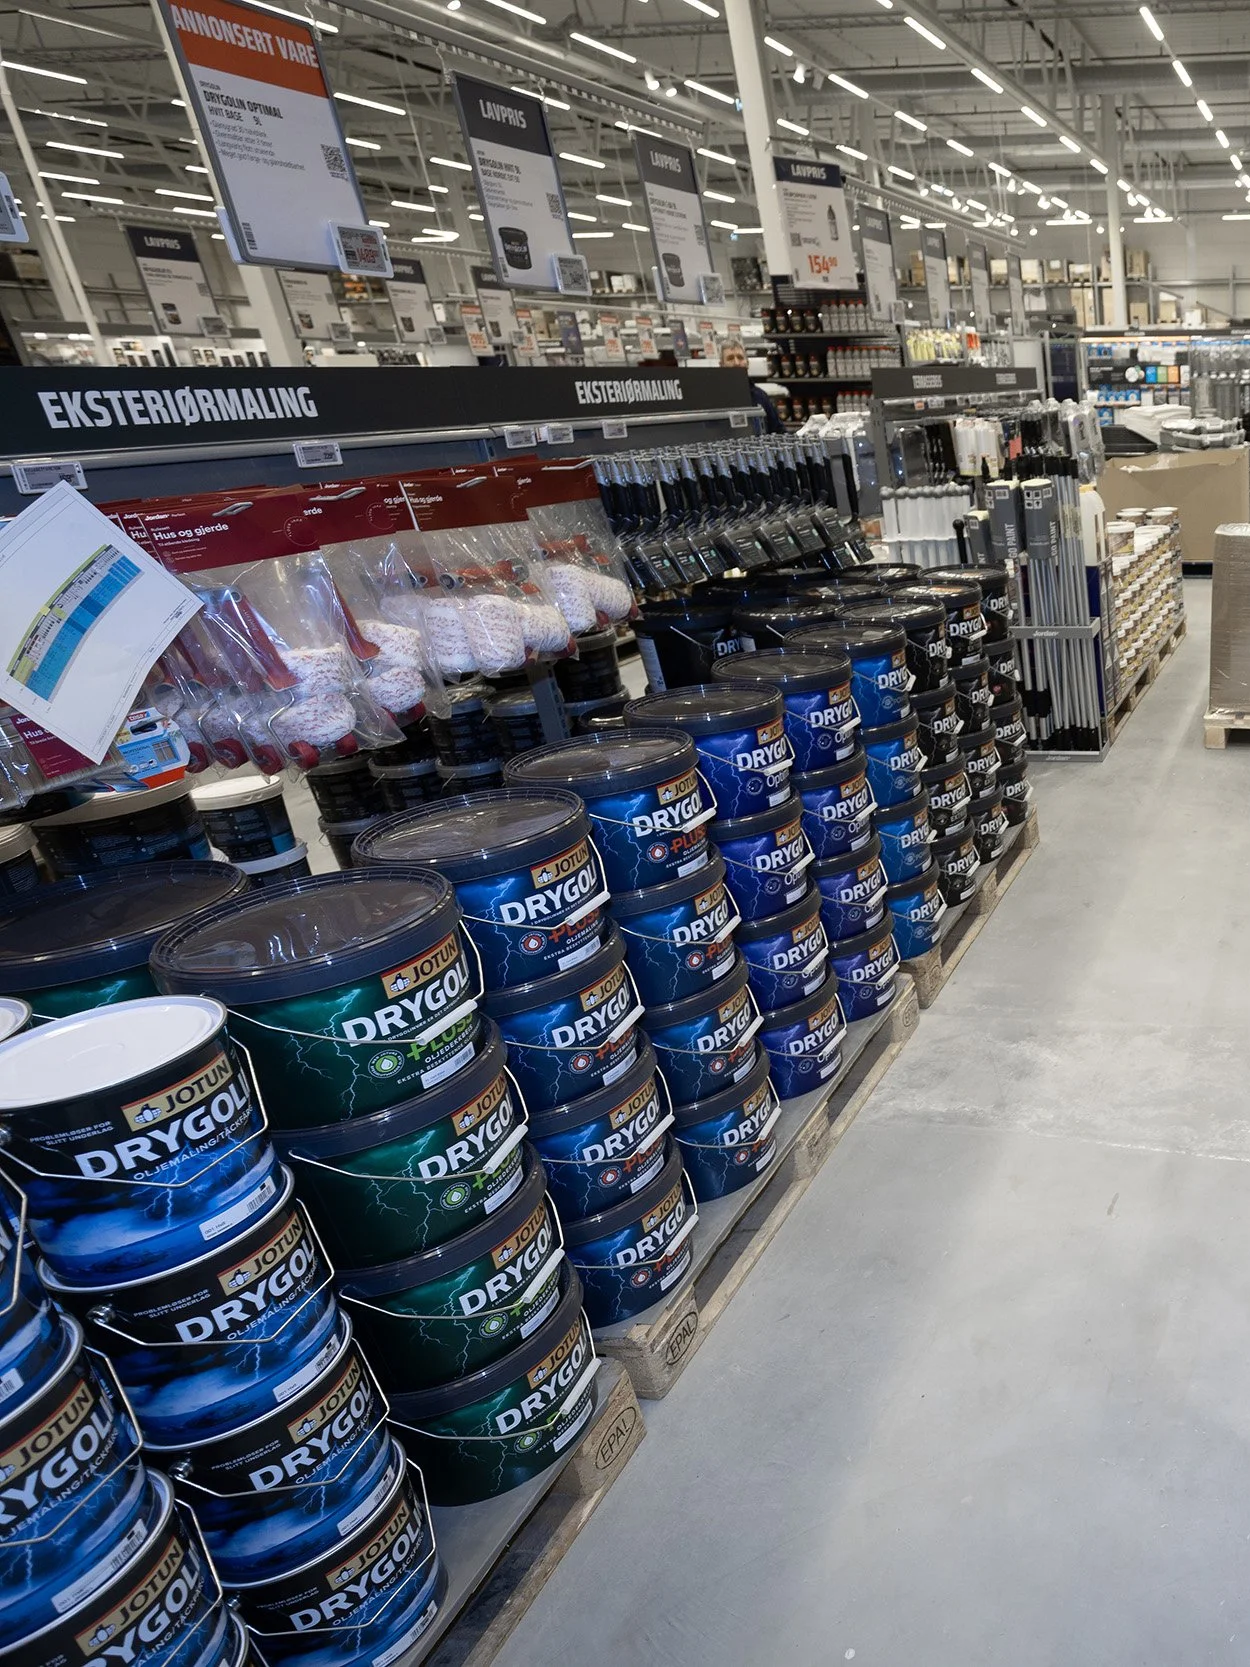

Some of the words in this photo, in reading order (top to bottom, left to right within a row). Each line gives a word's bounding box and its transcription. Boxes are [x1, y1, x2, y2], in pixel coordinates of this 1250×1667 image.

[171, 5, 275, 56] ANNONSERT
[276, 36, 320, 68] VARE
[203, 90, 247, 111] DRYGOLIN
[246, 101, 283, 119] OPTIMAL
[479, 98, 527, 129] LAVPRIS
[650, 149, 682, 174] LAVPRIS
[791, 162, 827, 181] LAVPRIS
[574, 379, 683, 405] EKSTERIØRMALING
[37, 386, 318, 429] EKSTERIØRMALING
[145, 513, 169, 521] Jordan
[153, 532, 177, 541] Hus
[178, 528, 193, 538] og
[195, 522, 229, 537] gjerde
[23, 729, 43, 739] Hus
[555, 848, 588, 878] JOTUN
[412, 941, 458, 983] JOTUN
[543, 948, 566, 961] EKSTRA
[165, 1060, 230, 1114] JOTUN
[397, 1069, 425, 1084] EKSTRA
[69, 1125, 115, 1142] UNDERLAG
[93, 1120, 112, 1129] FOR
[464, 1200, 485, 1213] EKSTRA
[254, 1219, 304, 1274] JOTUN
[669, 1321, 696, 1360] EPAL
[320, 1362, 360, 1422] JOTUN
[19, 1387, 92, 1468] JOTUN
[599, 1417, 632, 1463] EPAL
[356, 1506, 408, 1568] JOTUN
[116, 1549, 183, 1624] JOTUN
